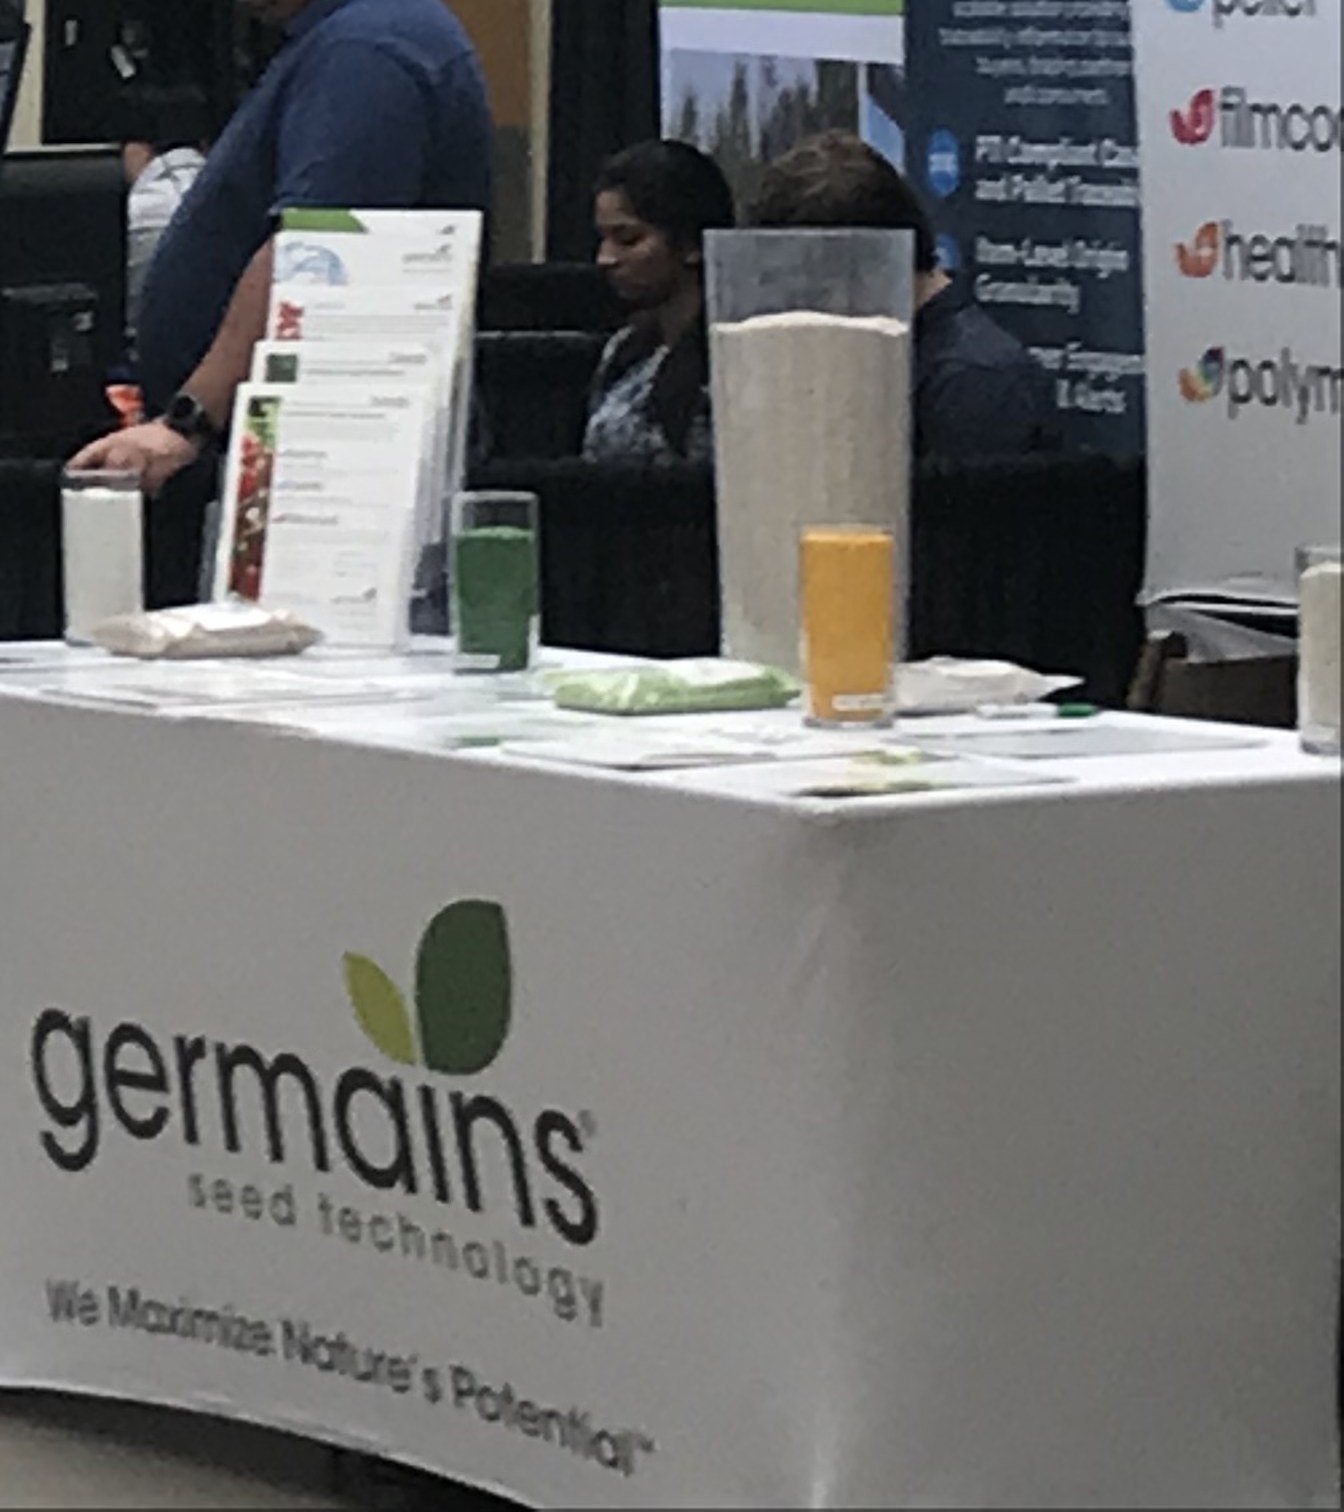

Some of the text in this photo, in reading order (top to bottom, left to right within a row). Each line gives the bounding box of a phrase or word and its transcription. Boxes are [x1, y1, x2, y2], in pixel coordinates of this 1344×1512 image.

[1220, 86, 1344, 151] filmco
[31, 1007, 599, 1245] germains
[188, 1170, 605, 1327] seed technology
[46, 1278, 100, 1326] We
[108, 1285, 273, 1357] Maximize
[282, 1319, 443, 1405] Nature's
